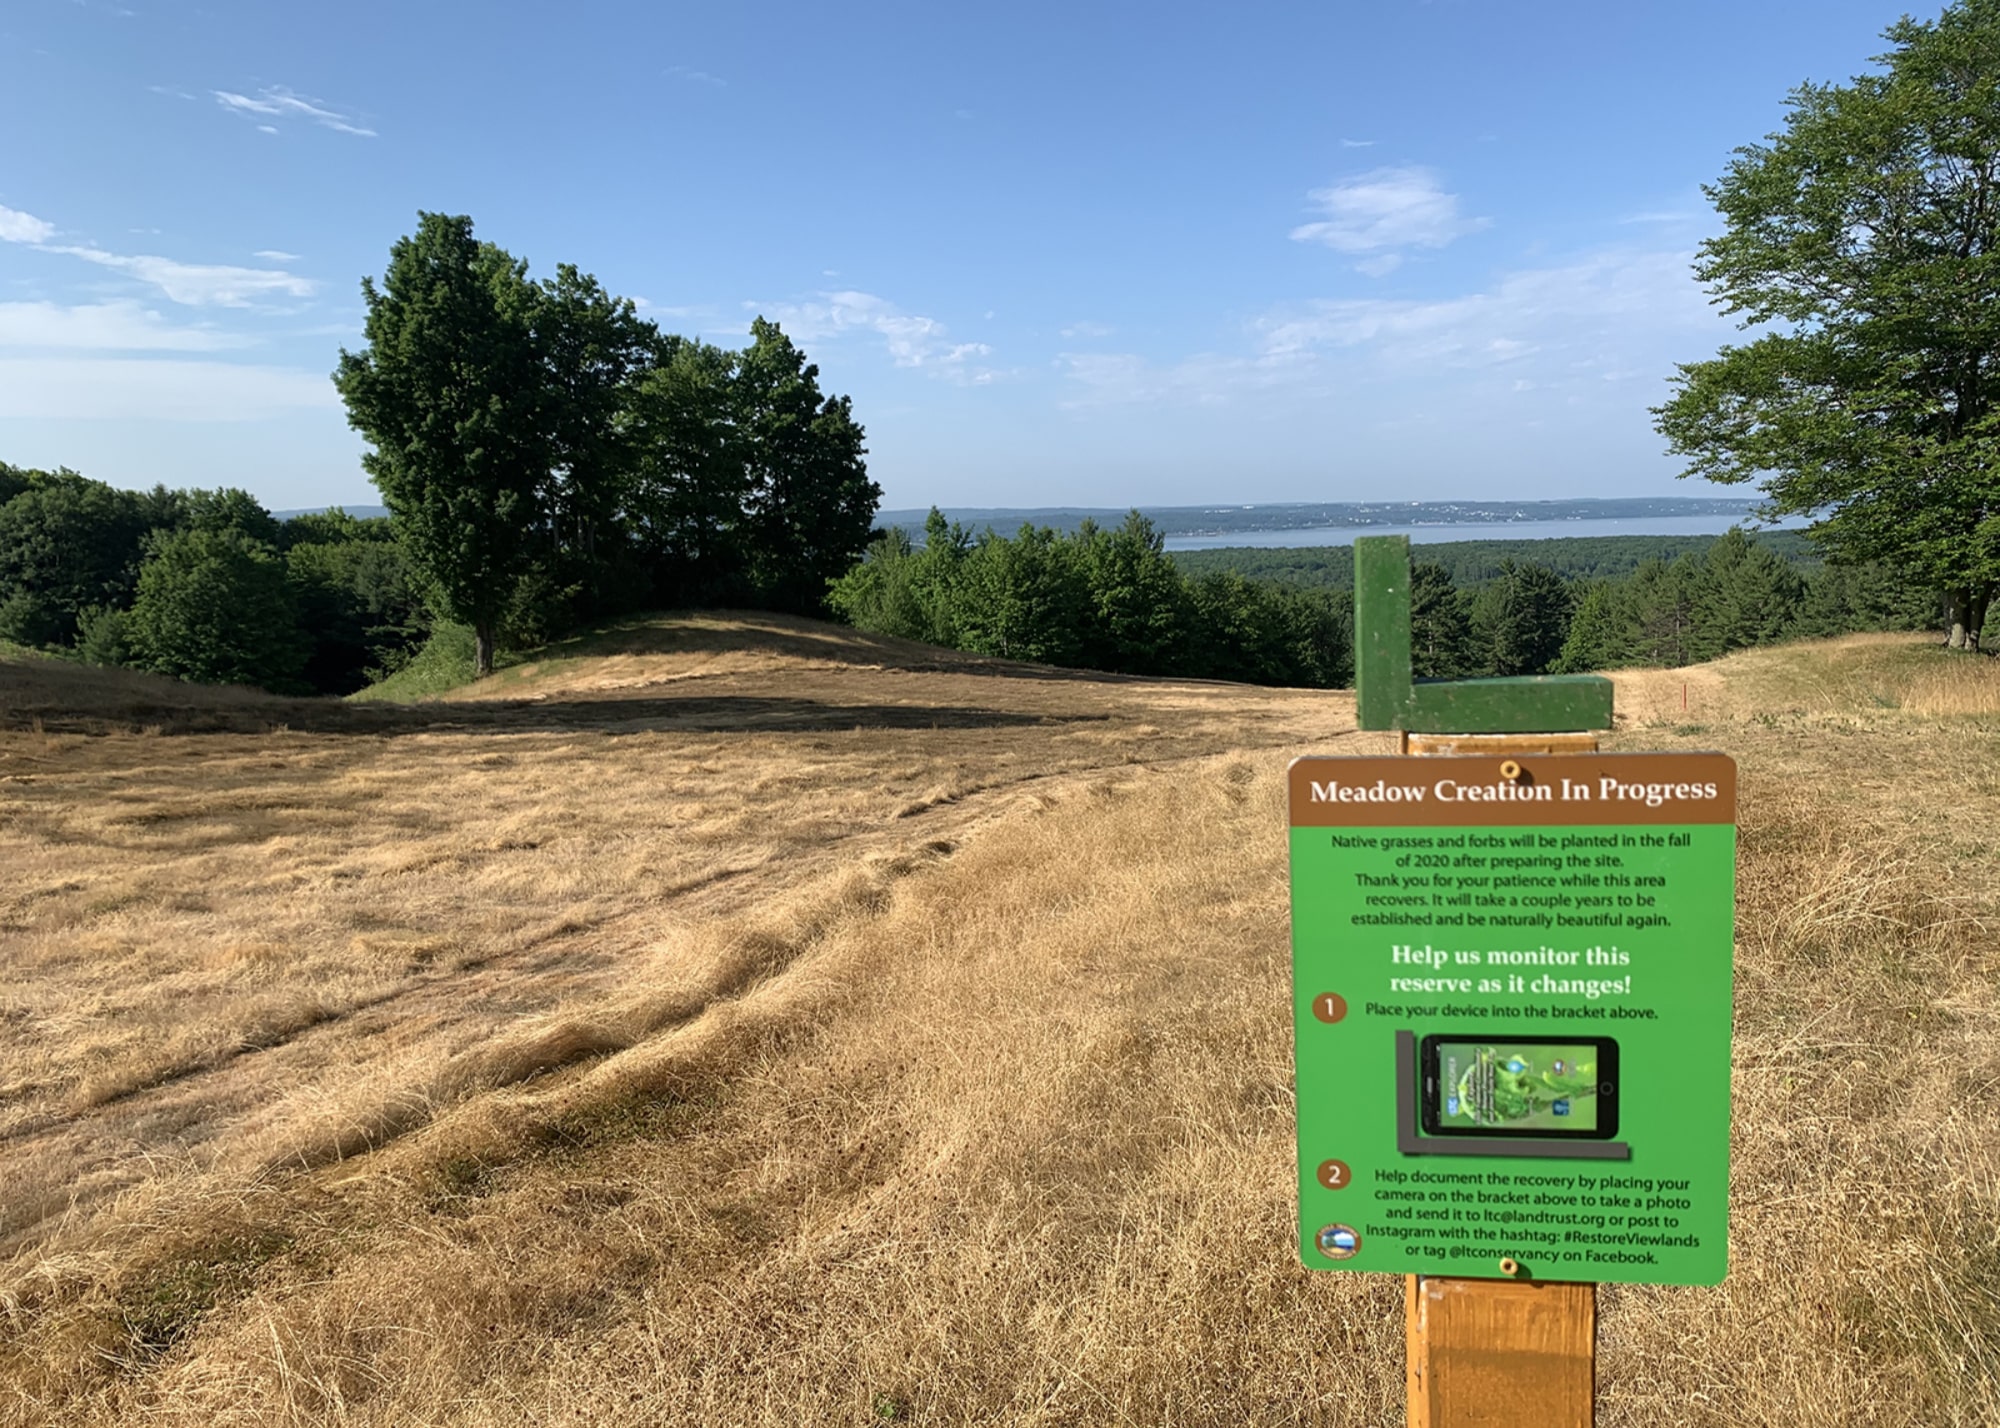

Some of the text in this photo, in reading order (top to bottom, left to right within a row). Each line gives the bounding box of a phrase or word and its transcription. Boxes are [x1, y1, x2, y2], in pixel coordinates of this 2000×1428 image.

[1311, 777, 1717, 807] Meadow Creation In Progress
[1331, 832, 1691, 852] Native grasses and forbs will be planted in the fall
[1395, 853, 1625, 871] of 2020 after preparing the site.
[1354, 872, 1666, 891] Thank you for your patience while this area
[1365, 892, 1656, 910] recovers. It will take a couple years to be
[1350, 911, 1672, 931] established and be naturally beautiful again.
[1392, 944, 1630, 970] Help us monitor this
[1390, 973, 1631, 999] reserve as it changes!
[1324, 997, 1334, 1017] 1
[1365, 1002, 1659, 1020] Place your device into the bracket above.
[1328, 1165, 1341, 1184] 2
[1374, 1169, 1691, 1193] Help document the recovery by placing your
[1374, 1189, 1692, 1212] camera on the bracket above to take a photo
[1385, 1205, 1413, 1220] and
[1415, 1207, 1450, 1221] send
[1452, 1207, 1463, 1222] it
[1465, 1209, 1481, 1222] to
[1608, 1215, 1625, 1227] or
[1627, 1215, 1660, 1230] post
[1663, 1215, 1680, 1229] to
[1365, 1223, 1436, 1241] Instagram
[1438, 1225, 1470, 1240] with
[1472, 1226, 1497, 1241] the
[1499, 1227, 1561, 1246] hashtag:
[1563, 1229, 1701, 1248] #RestoreViewlands
[1404, 1245, 1421, 1256] or
[1422, 1244, 1447, 1261] tag
[1562, 1250, 1583, 1262] on
[1585, 1248, 1659, 1265] Facebook.
